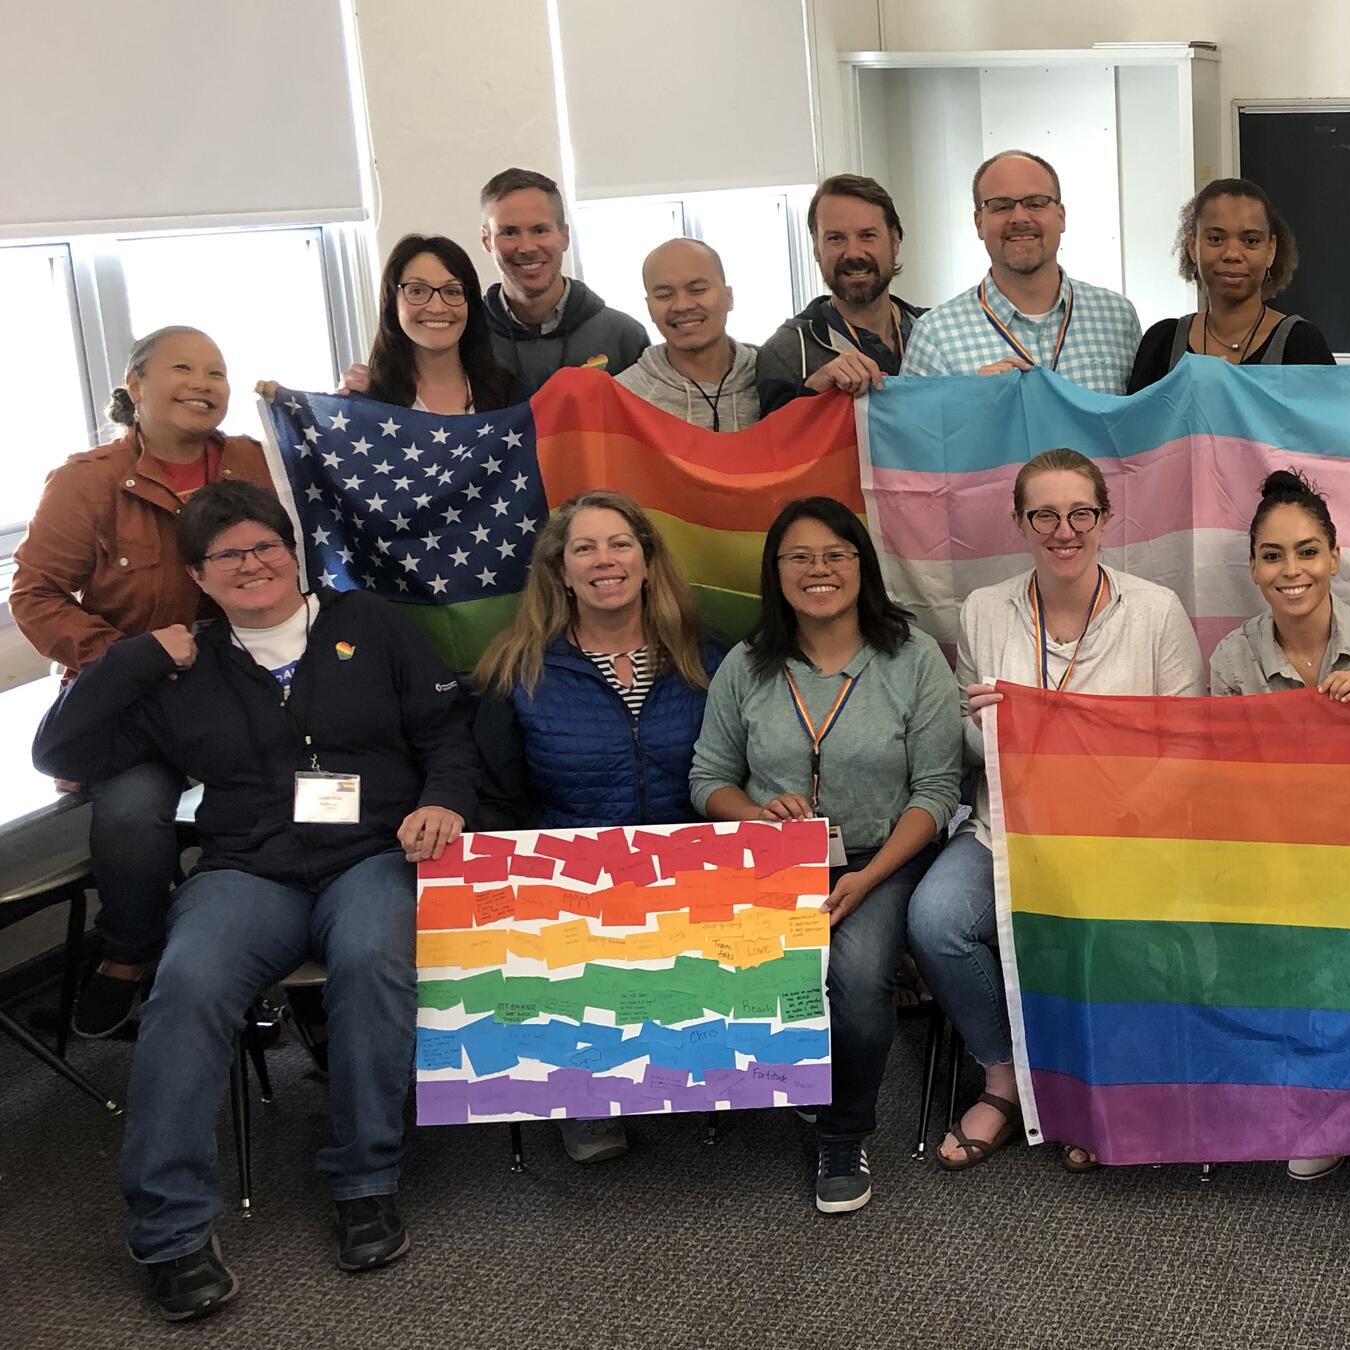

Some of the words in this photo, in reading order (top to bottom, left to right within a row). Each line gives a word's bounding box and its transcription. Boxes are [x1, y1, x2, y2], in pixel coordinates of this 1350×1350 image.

[562, 893, 591, 911] MOM
[742, 999, 775, 1014] Beach
[689, 1028, 720, 1044] Chris
